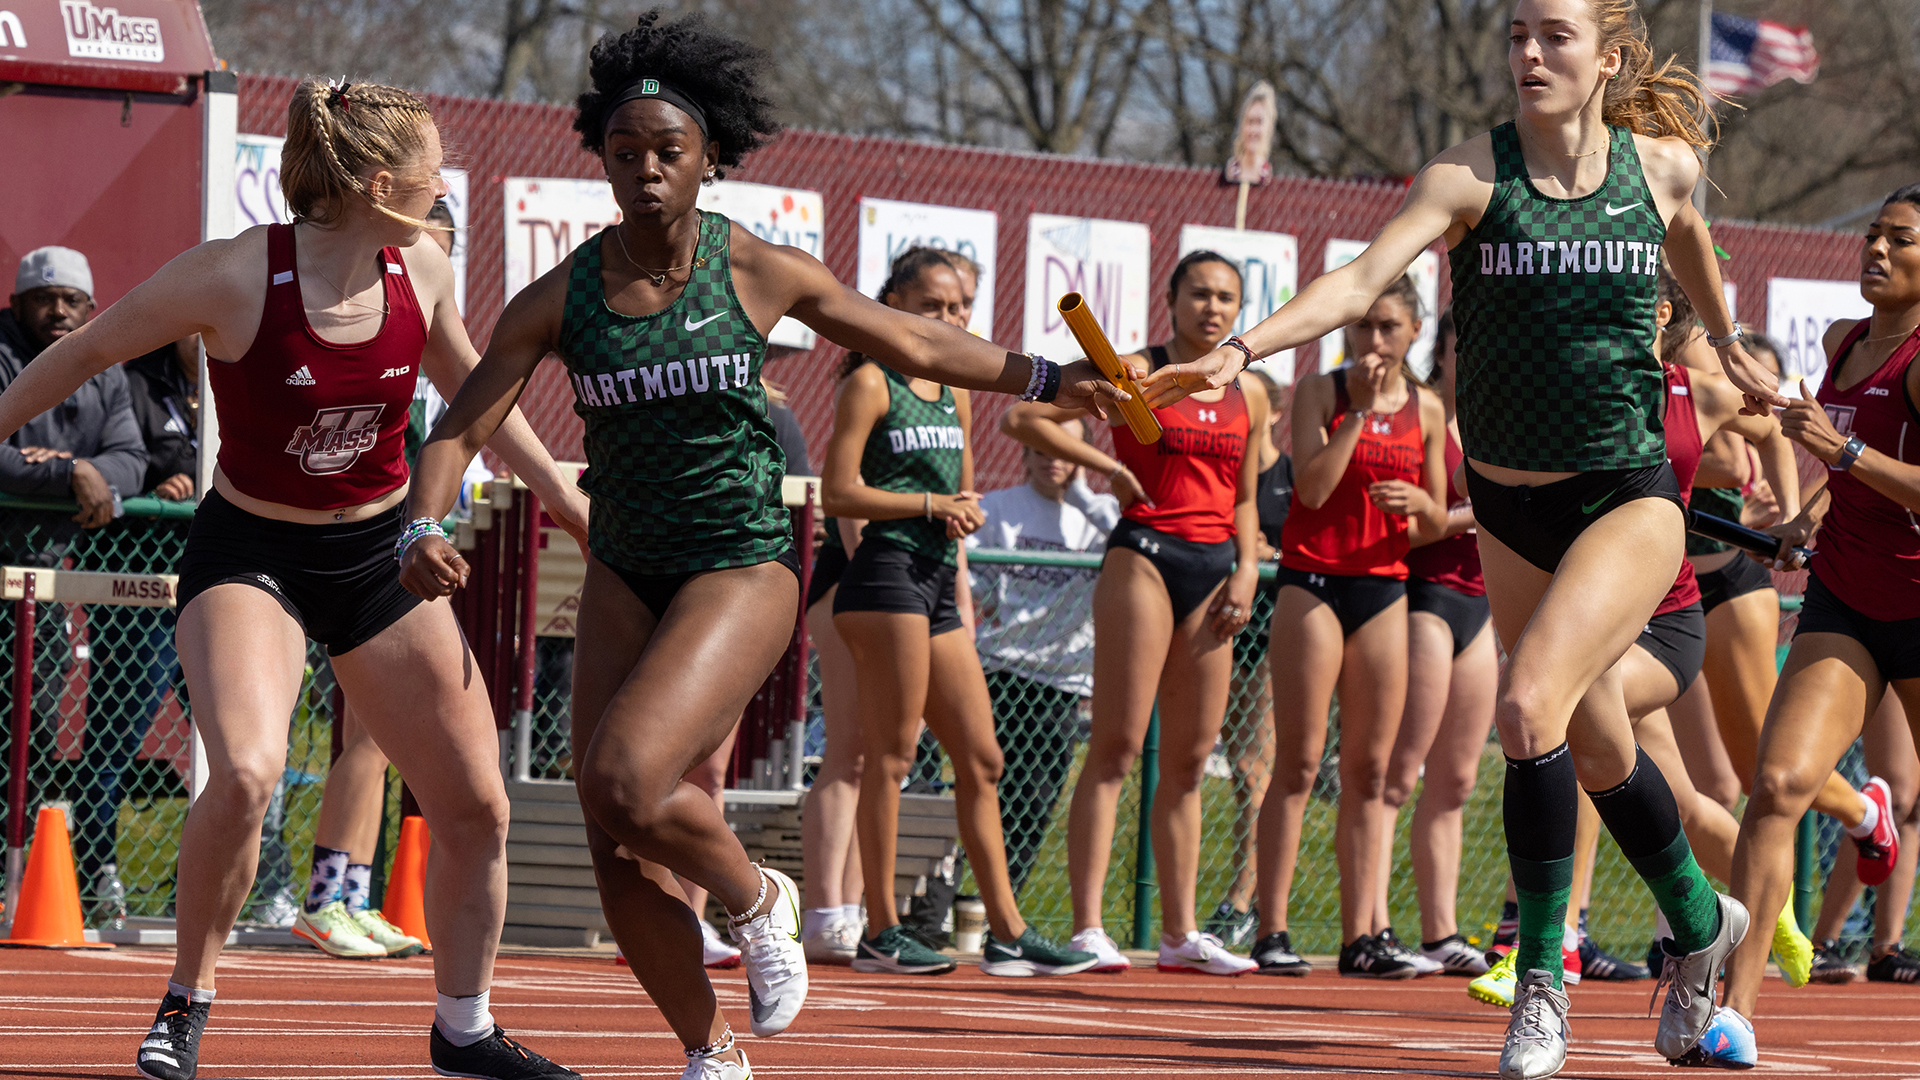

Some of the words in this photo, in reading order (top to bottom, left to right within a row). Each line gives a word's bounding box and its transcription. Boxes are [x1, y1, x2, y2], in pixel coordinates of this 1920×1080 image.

[642, 79, 659, 94] D
[1478, 240, 1660, 276] DARTMOUTH
[379, 365, 410, 380] A10
[573, 352, 750, 407] DARTMOUTH
[285, 378, 316, 386] adidas
[1863, 386, 1890, 397] A10
[112, 579, 178, 599] MASSA
